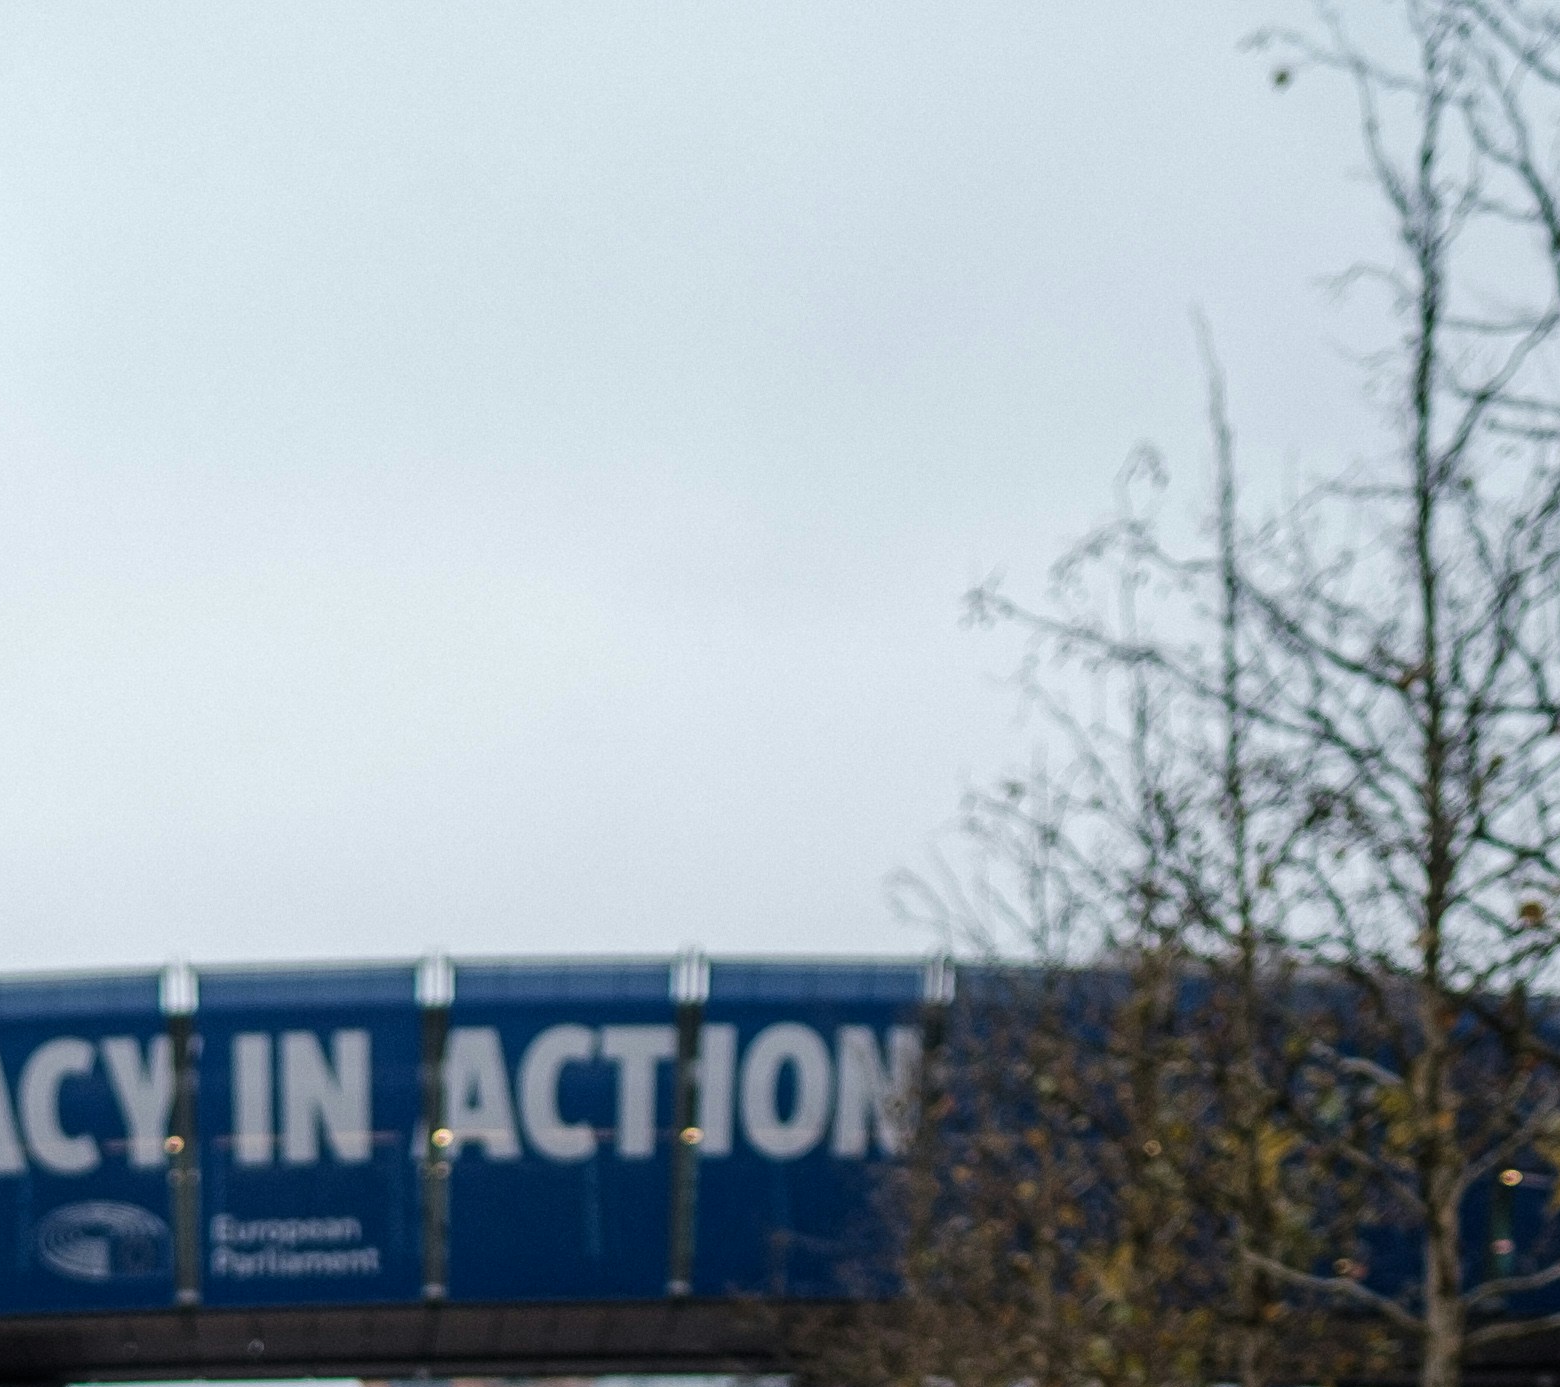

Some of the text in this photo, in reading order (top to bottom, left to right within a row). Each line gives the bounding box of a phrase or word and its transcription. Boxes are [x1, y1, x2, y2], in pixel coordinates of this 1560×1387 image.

[233, 1029, 372, 1163] IN
[410, 1022, 923, 1160] ACTION
[210, 1213, 362, 1246] European
[210, 1247, 379, 1280] Parliament
